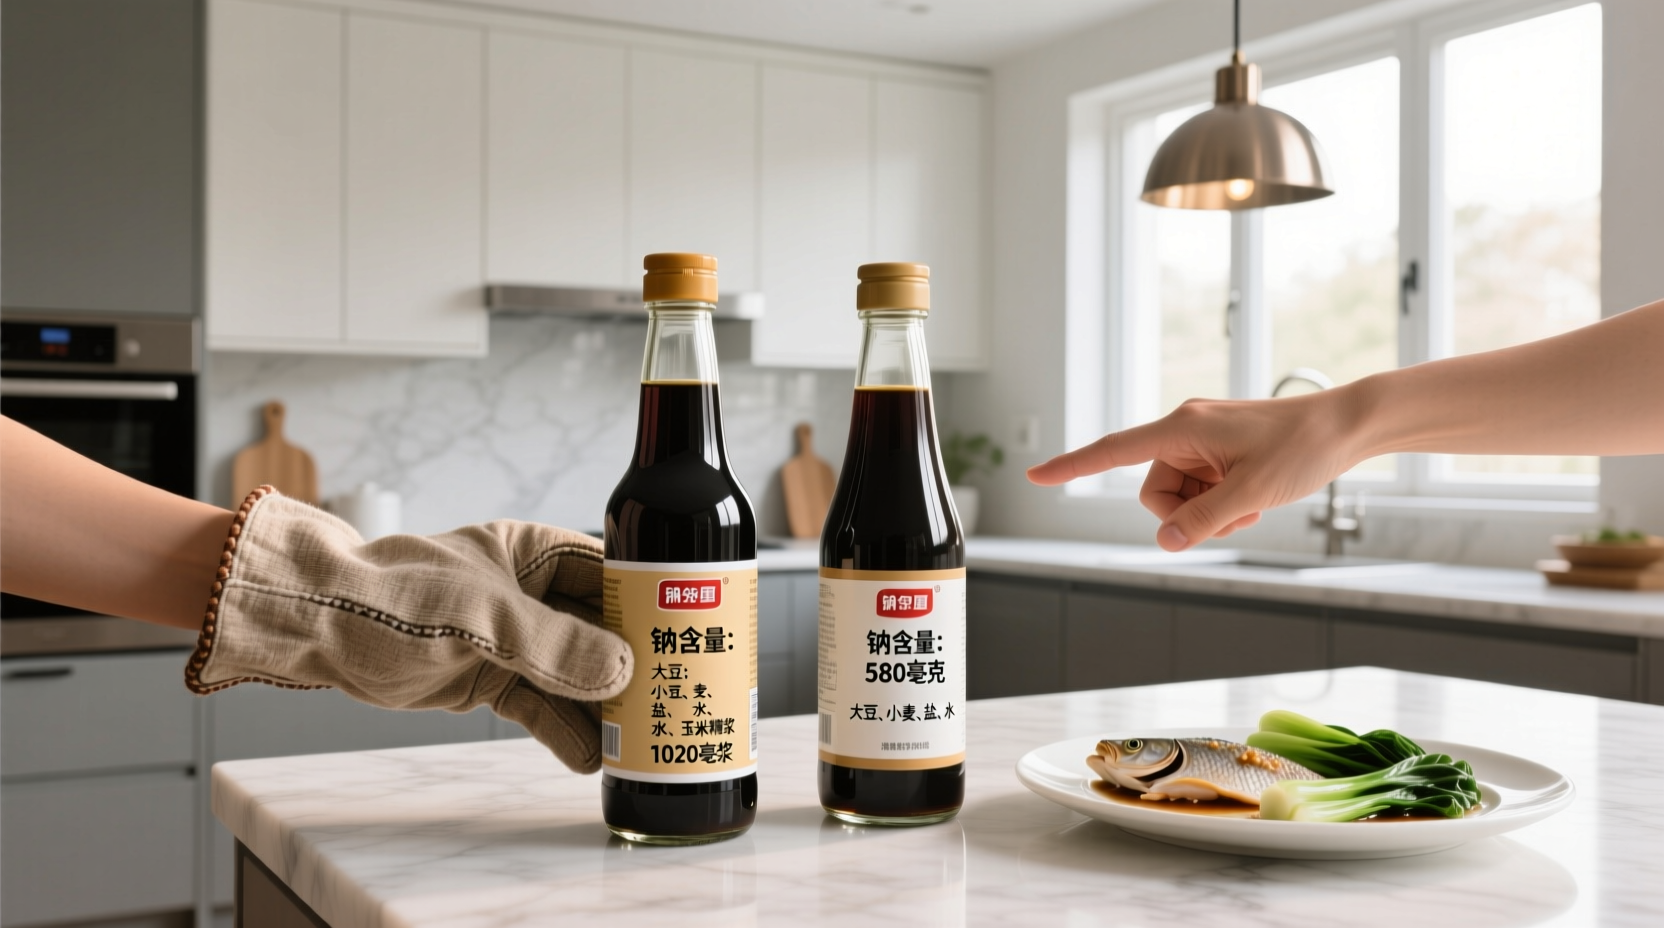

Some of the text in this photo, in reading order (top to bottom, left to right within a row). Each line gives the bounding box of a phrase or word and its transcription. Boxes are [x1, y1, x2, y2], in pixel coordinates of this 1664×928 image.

[651, 626, 733, 654] 钠含量：
[867, 629, 942, 655] 钠含量：
[865, 659, 945, 684] 580毫克
[850, 702, 955, 722] 大豆、小麦、盐、水
